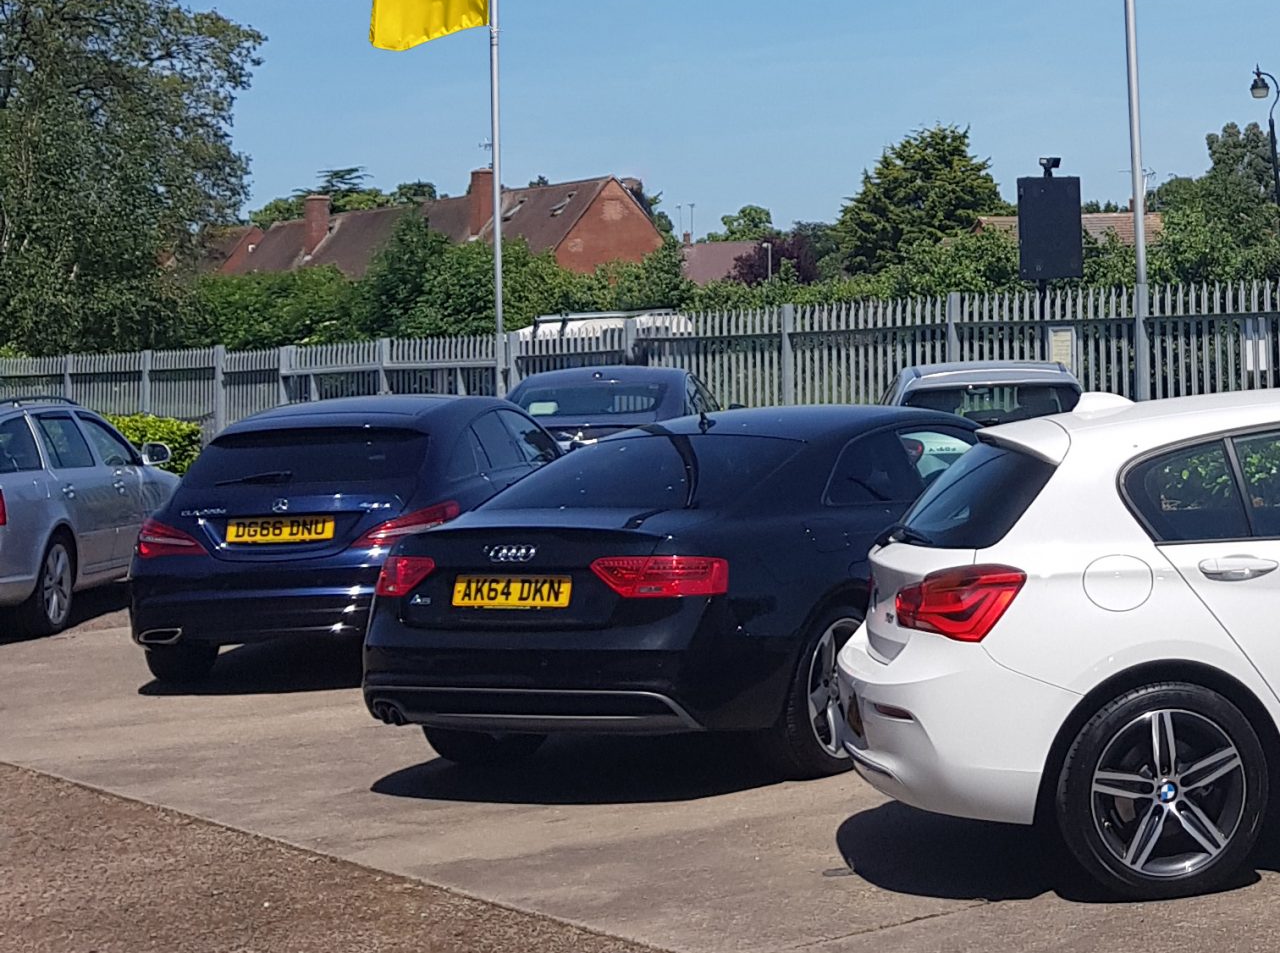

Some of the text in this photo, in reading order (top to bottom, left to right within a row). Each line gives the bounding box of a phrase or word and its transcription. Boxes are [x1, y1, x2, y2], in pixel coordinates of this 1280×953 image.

[234, 518, 326, 538] DG66 DNU
[462, 579, 562, 601] AK64 DKN
